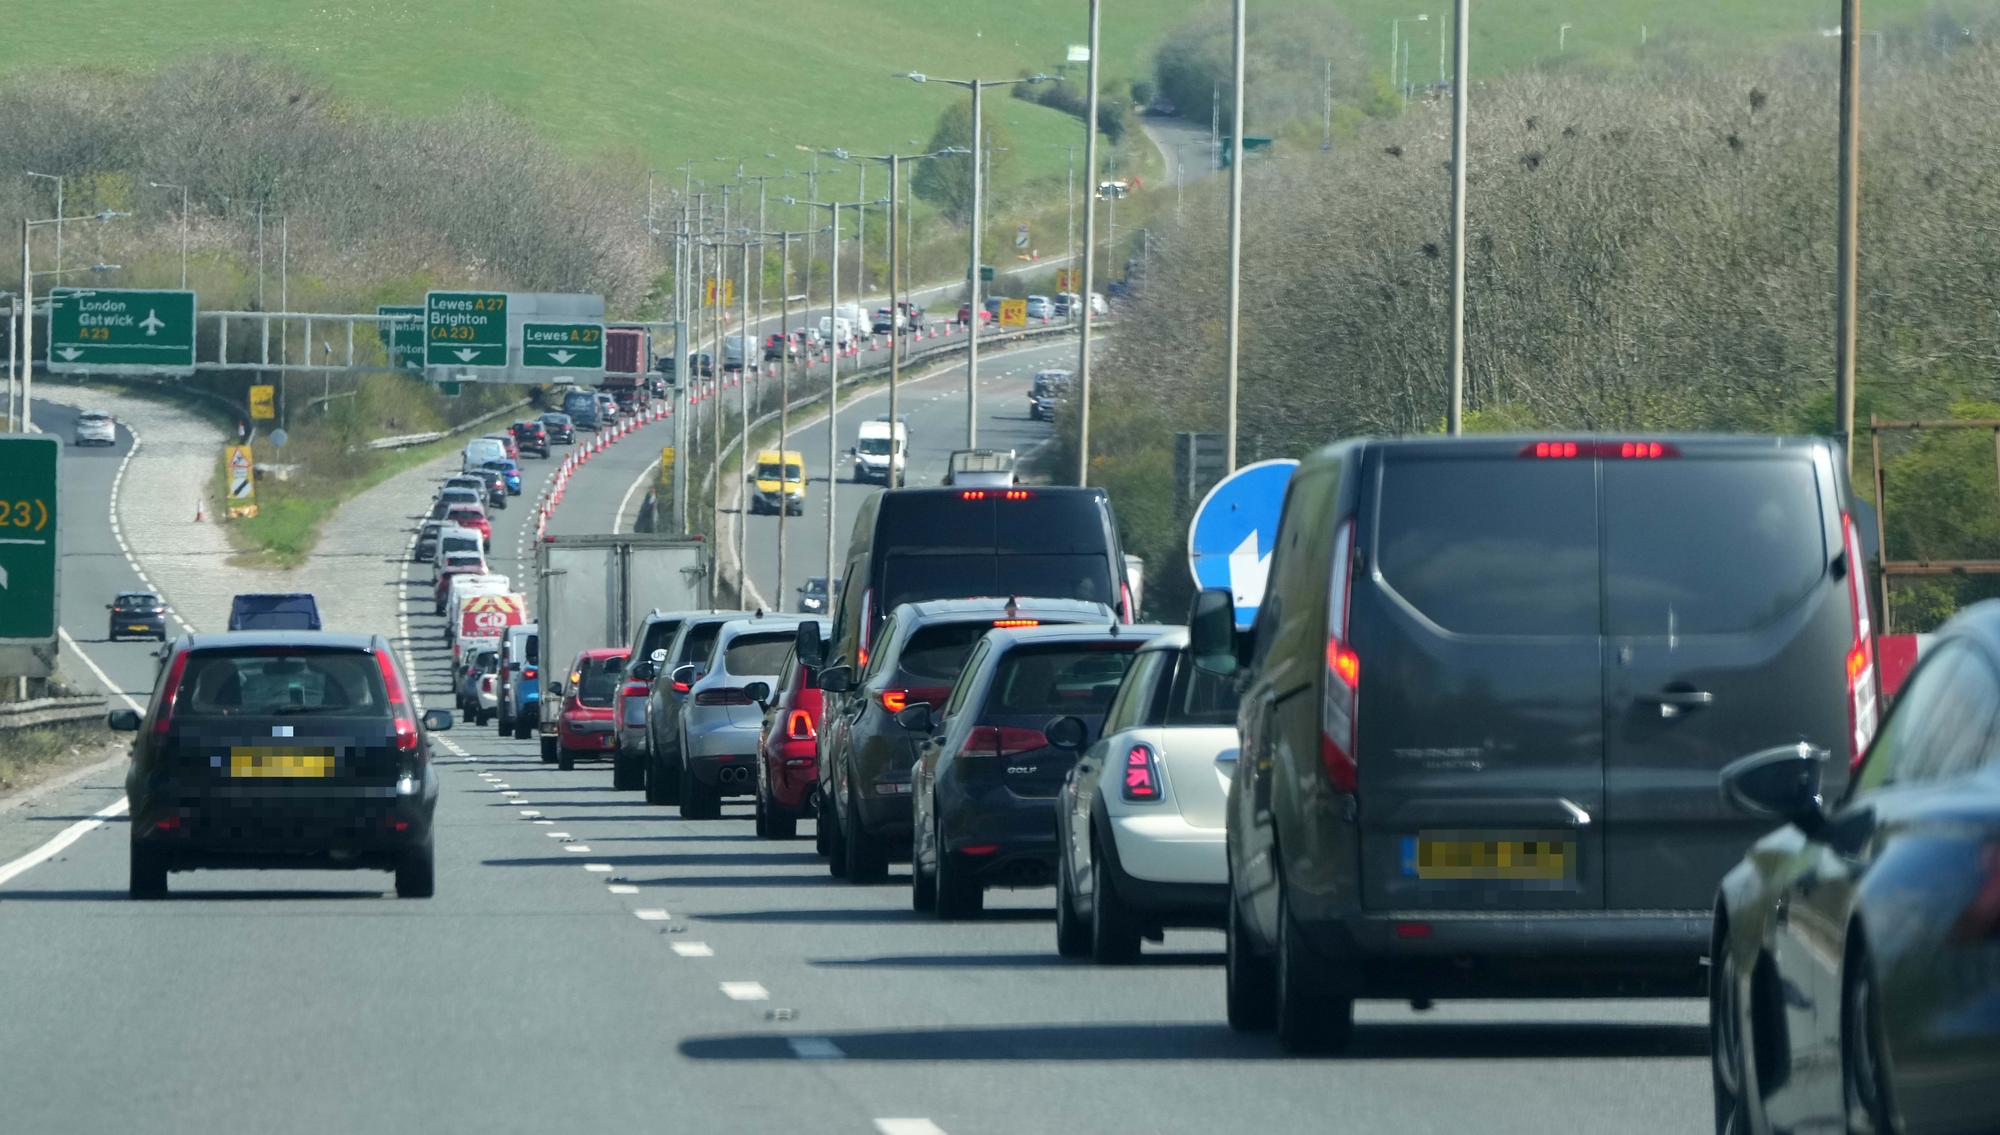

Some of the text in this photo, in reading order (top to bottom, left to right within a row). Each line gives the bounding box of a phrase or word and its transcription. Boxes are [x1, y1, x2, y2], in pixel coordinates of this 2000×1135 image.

[78, 299, 126, 312] London
[431, 298, 473, 310] Lewes
[78, 313, 133, 326] Gatwick
[431, 312, 488, 326] Brighton
[526, 329, 568, 341] Lewes
[1007, 766, 1037, 774] GOLF
